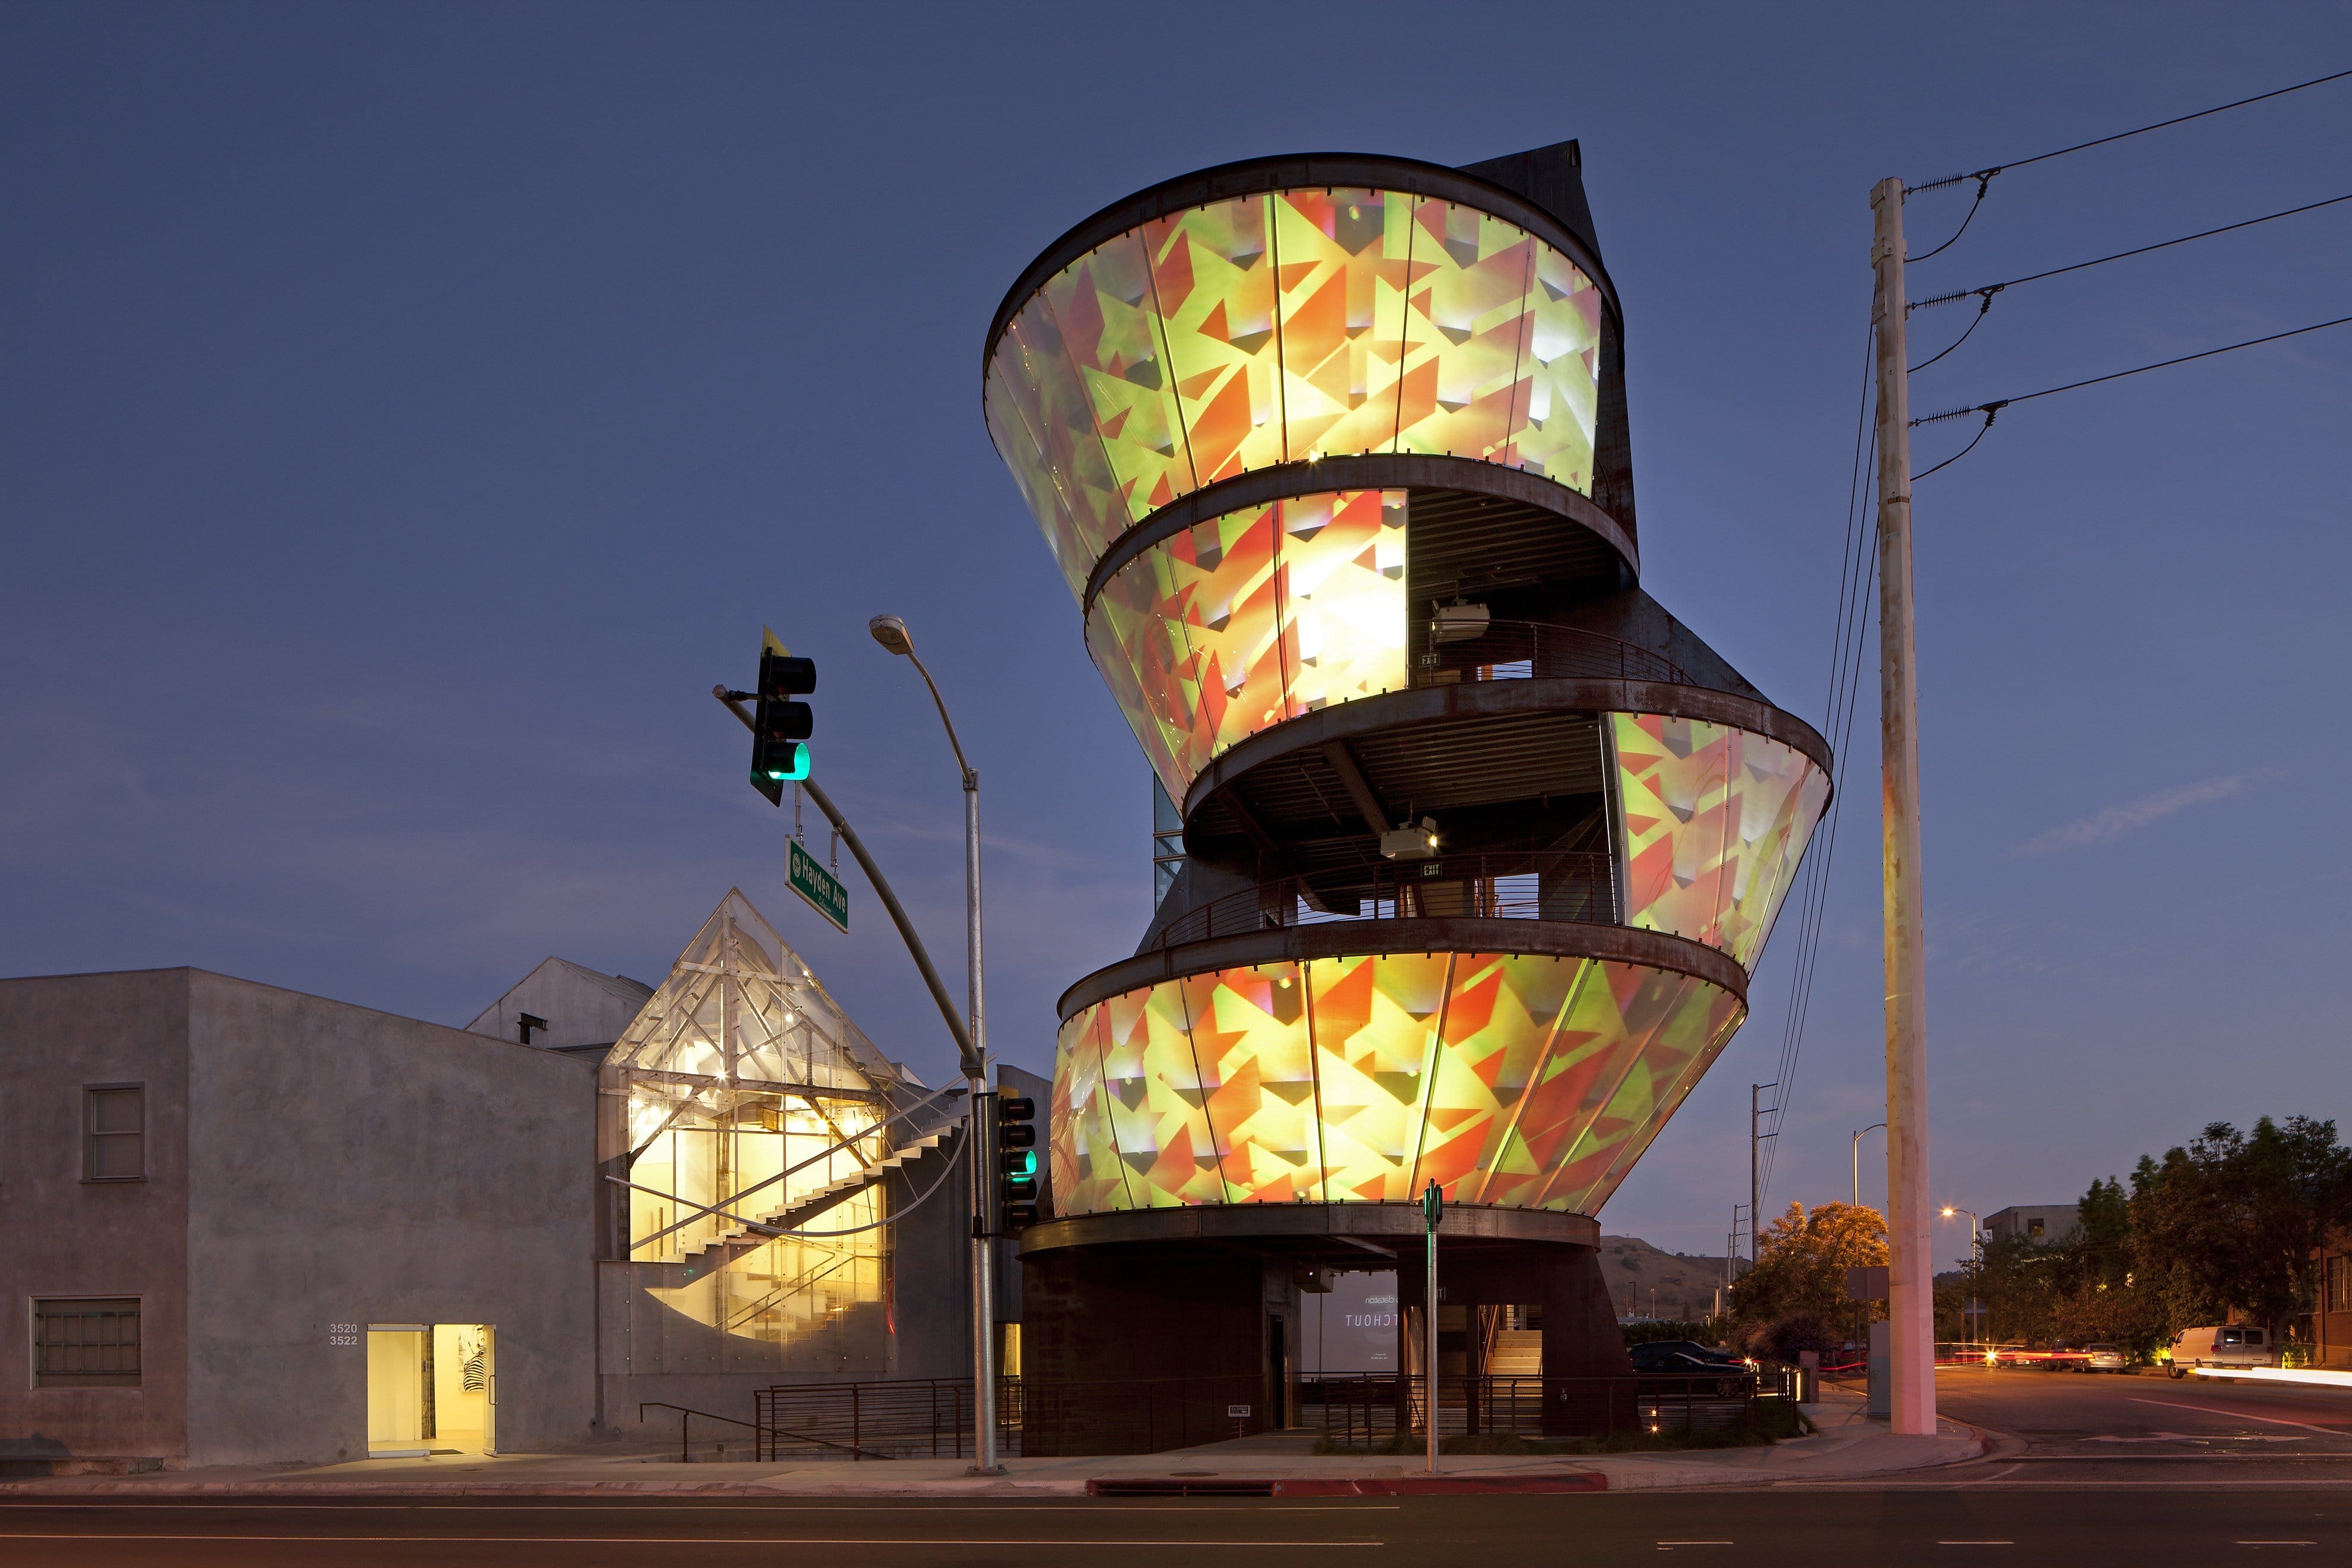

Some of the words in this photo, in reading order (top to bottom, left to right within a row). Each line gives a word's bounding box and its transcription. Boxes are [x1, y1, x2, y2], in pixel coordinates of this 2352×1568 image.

[1422, 653, 1437, 664] EXT
[1424, 864, 1440, 875] EXIT
[802, 856, 830, 900] Hayden
[833, 885, 846, 913] Ave
[330, 1324, 357, 1333] 3520
[330, 1336, 358, 1345] 3522
